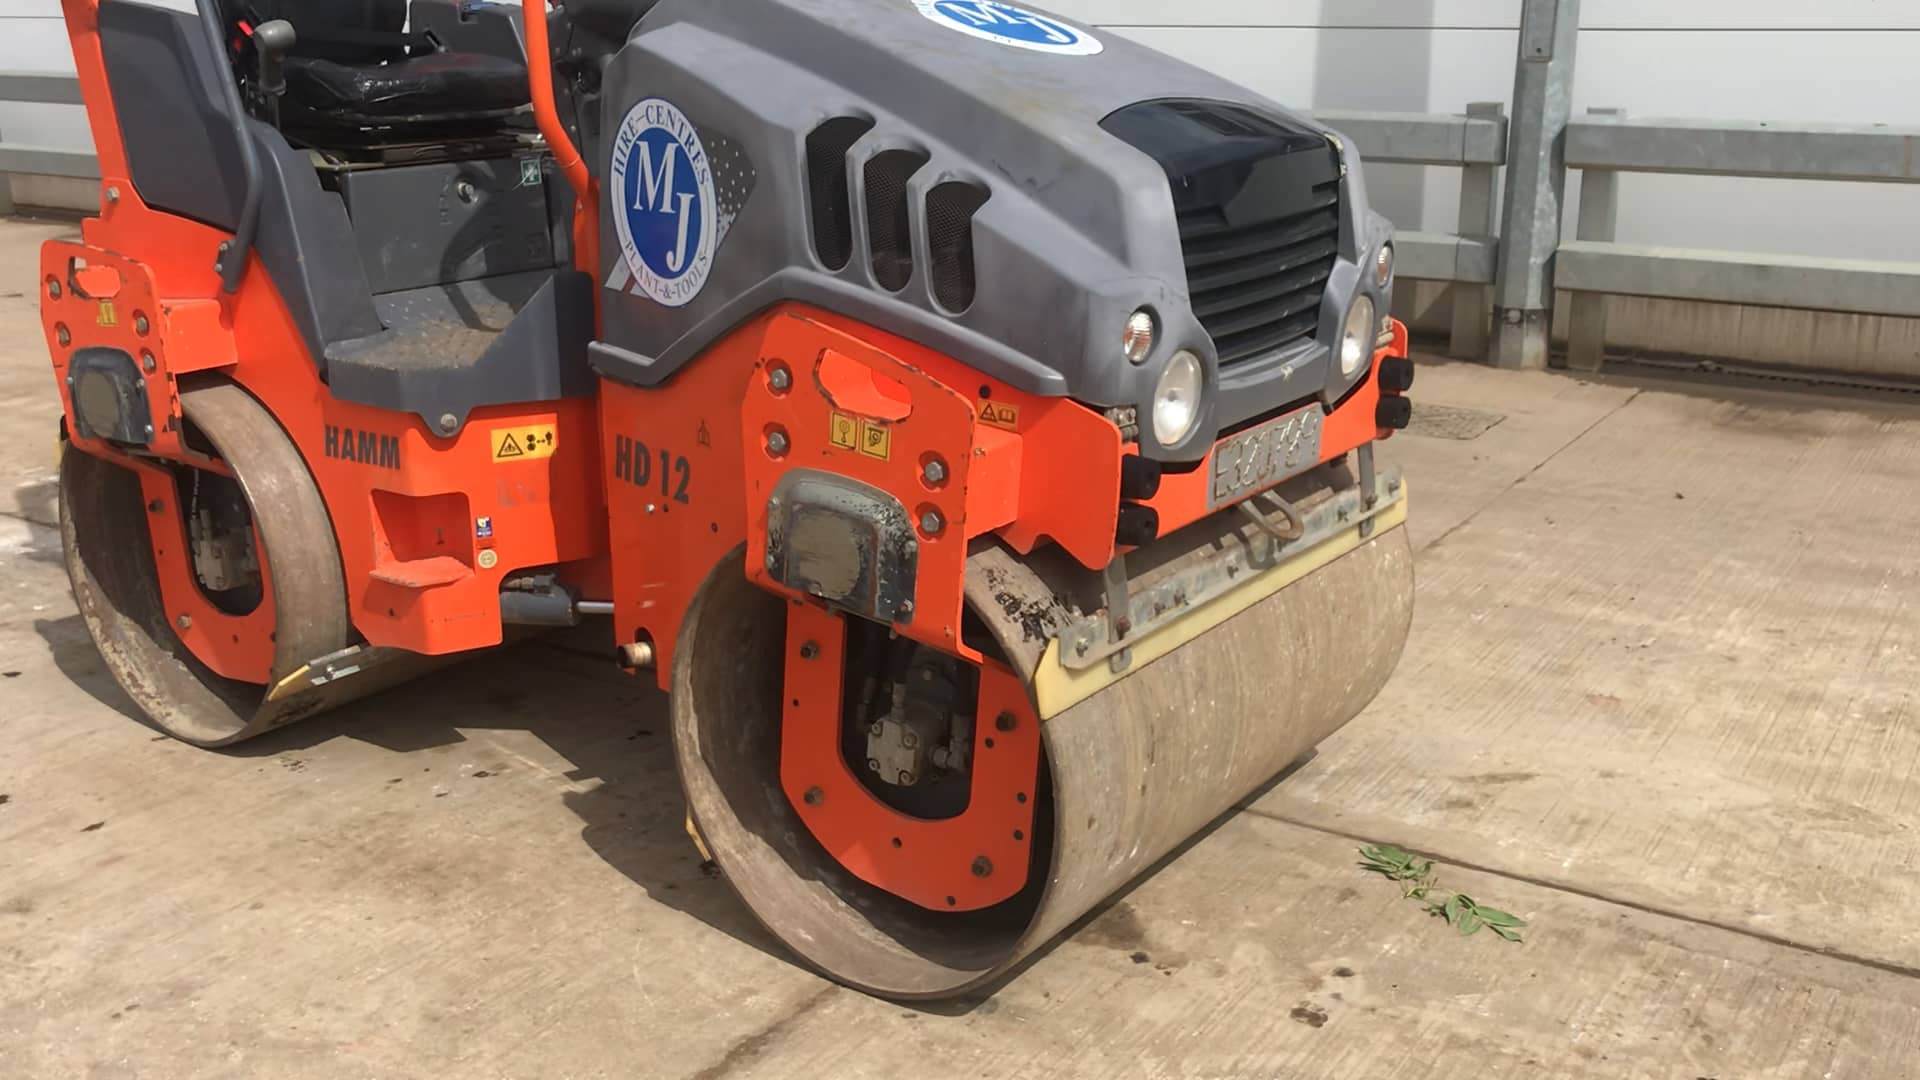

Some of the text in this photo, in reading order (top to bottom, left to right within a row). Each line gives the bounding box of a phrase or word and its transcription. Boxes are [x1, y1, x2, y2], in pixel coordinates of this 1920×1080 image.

[936, 2, 1072, 43] MJ
[633, 140, 696, 273] MJ
[324, 424, 401, 470] HAMM
[615, 433, 690, 505] HD 12
